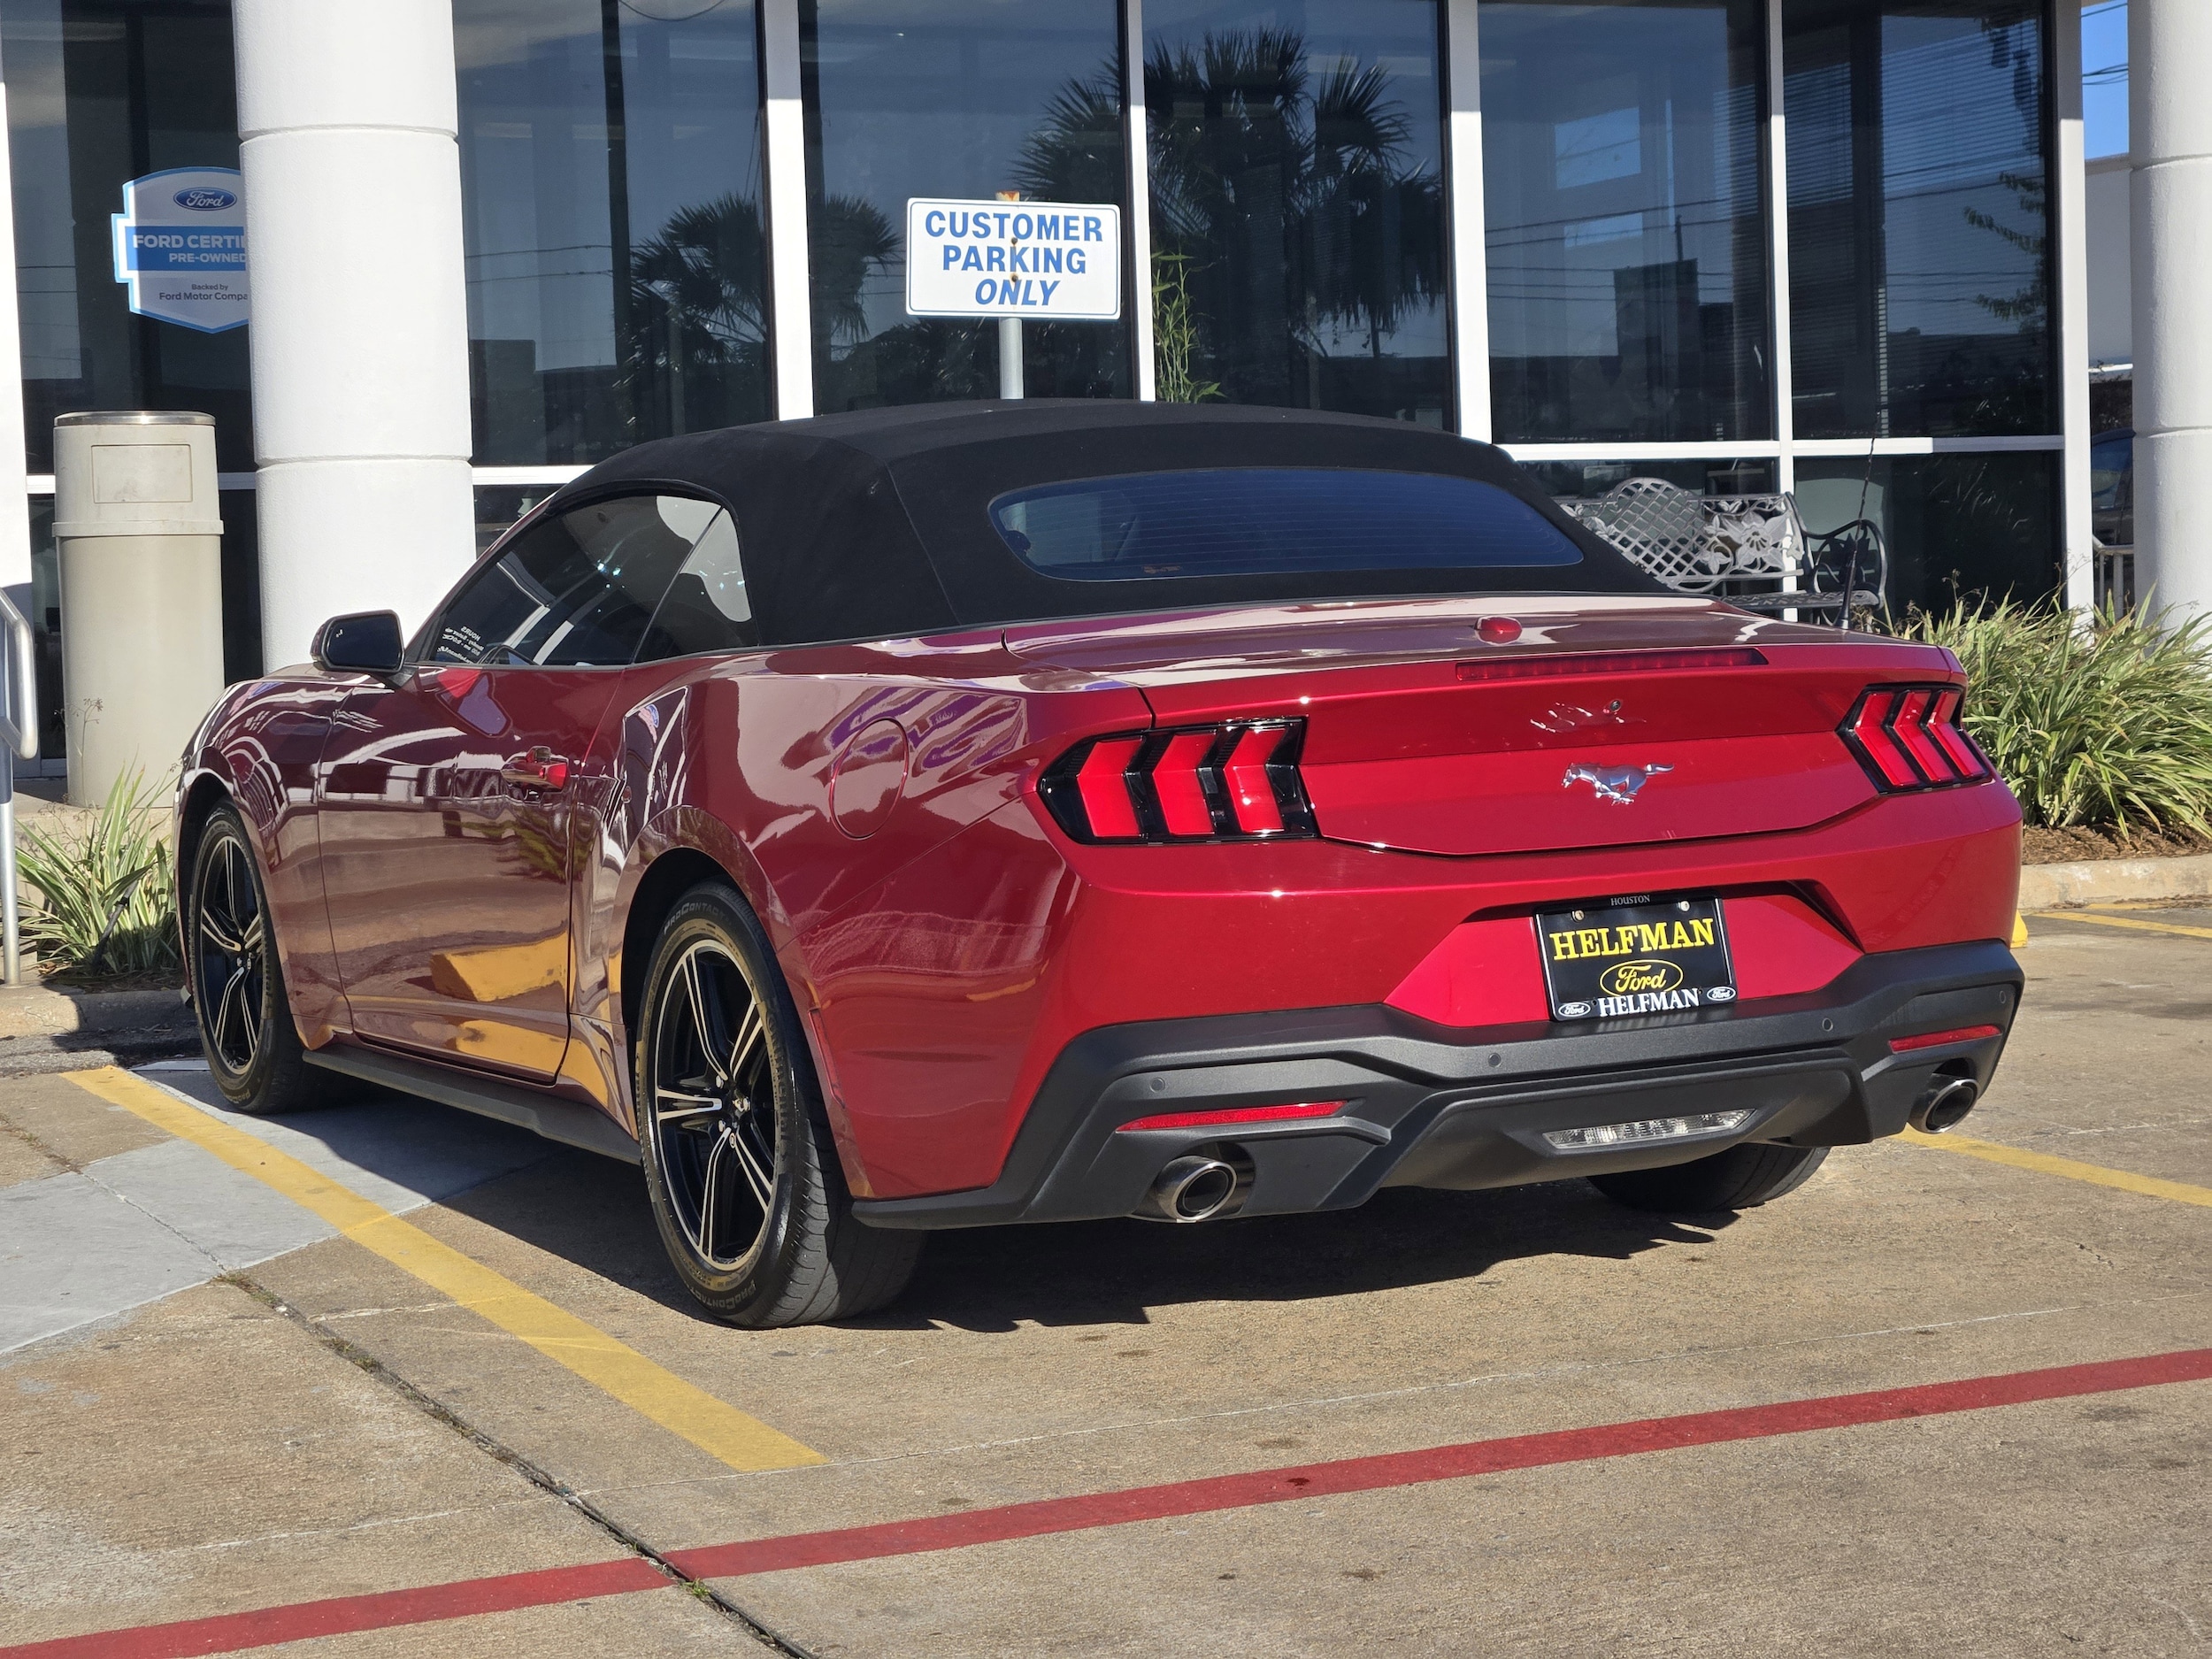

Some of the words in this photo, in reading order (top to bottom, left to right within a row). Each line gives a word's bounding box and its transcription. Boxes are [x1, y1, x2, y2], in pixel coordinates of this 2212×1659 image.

[186, 191, 224, 207] Ford
[925, 211, 1103, 242] CUSTOMER
[134, 234, 184, 249] FORD
[169, 253, 246, 263] PRE-OWNED
[942, 244, 1087, 274] PARKING
[975, 278, 1061, 306] ONLY
[1610, 895, 1650, 906] HOUSTON
[1549, 918, 1715, 961] HELFMAN
[1614, 964, 1667, 993] Ford
[1597, 987, 1701, 1018] HELFMAN
[1710, 987, 1732, 1000] Ford
[1562, 1003, 1587, 1015] Ford
